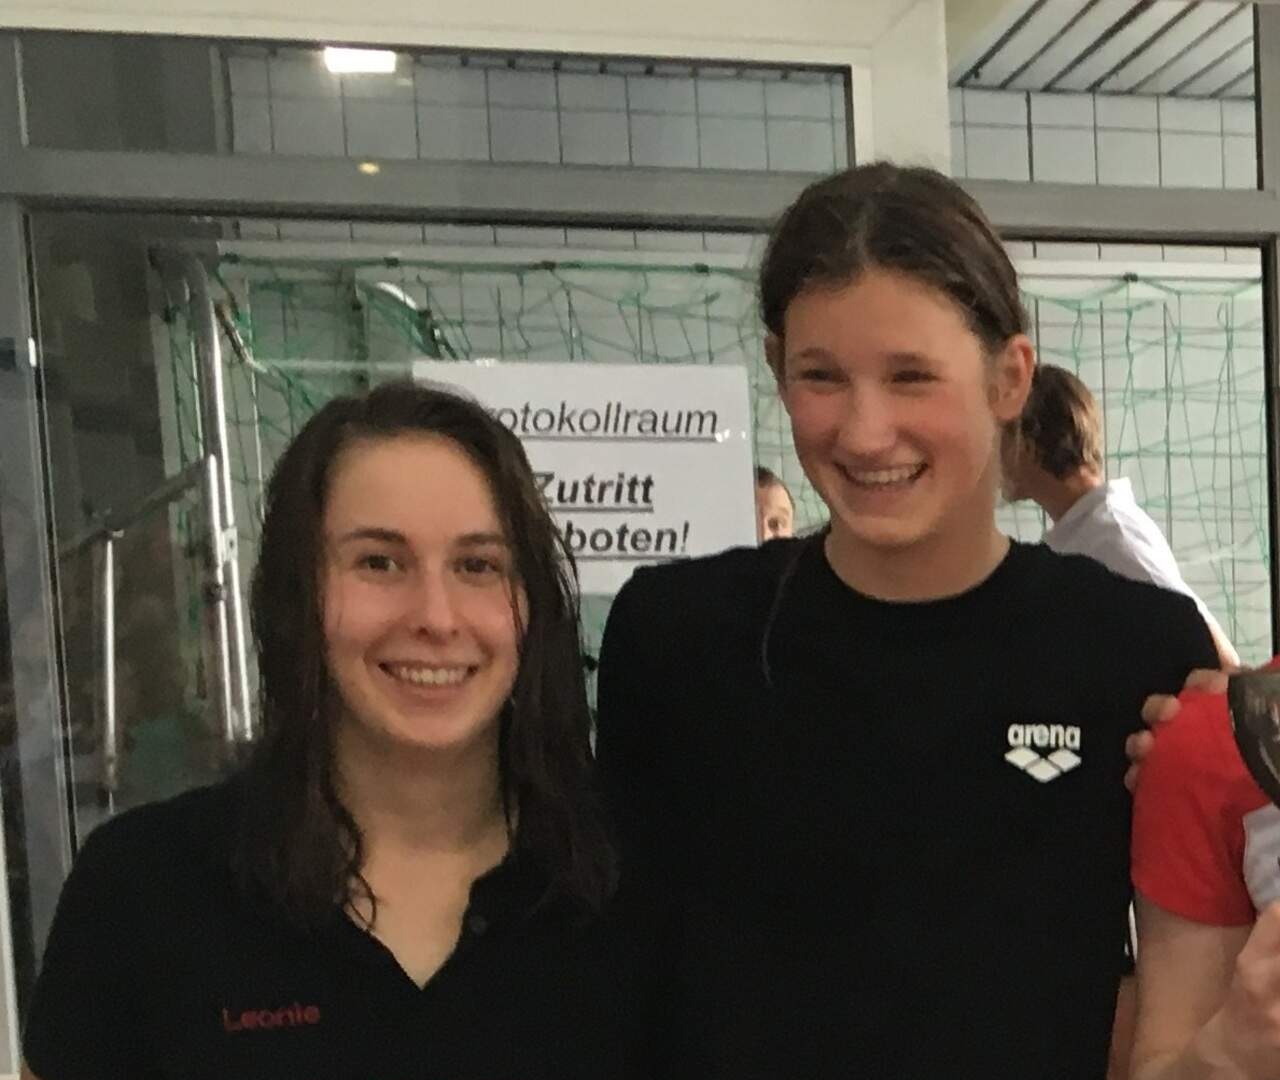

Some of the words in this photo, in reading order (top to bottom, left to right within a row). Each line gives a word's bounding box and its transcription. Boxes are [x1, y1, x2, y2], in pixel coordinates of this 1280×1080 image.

[492, 401, 718, 435] otokollraum
[532, 471, 655, 504] Zutritt
[562, 519, 690, 553] boten!
[1007, 723, 1081, 750] arena
[222, 1002, 320, 1033] Leonie
